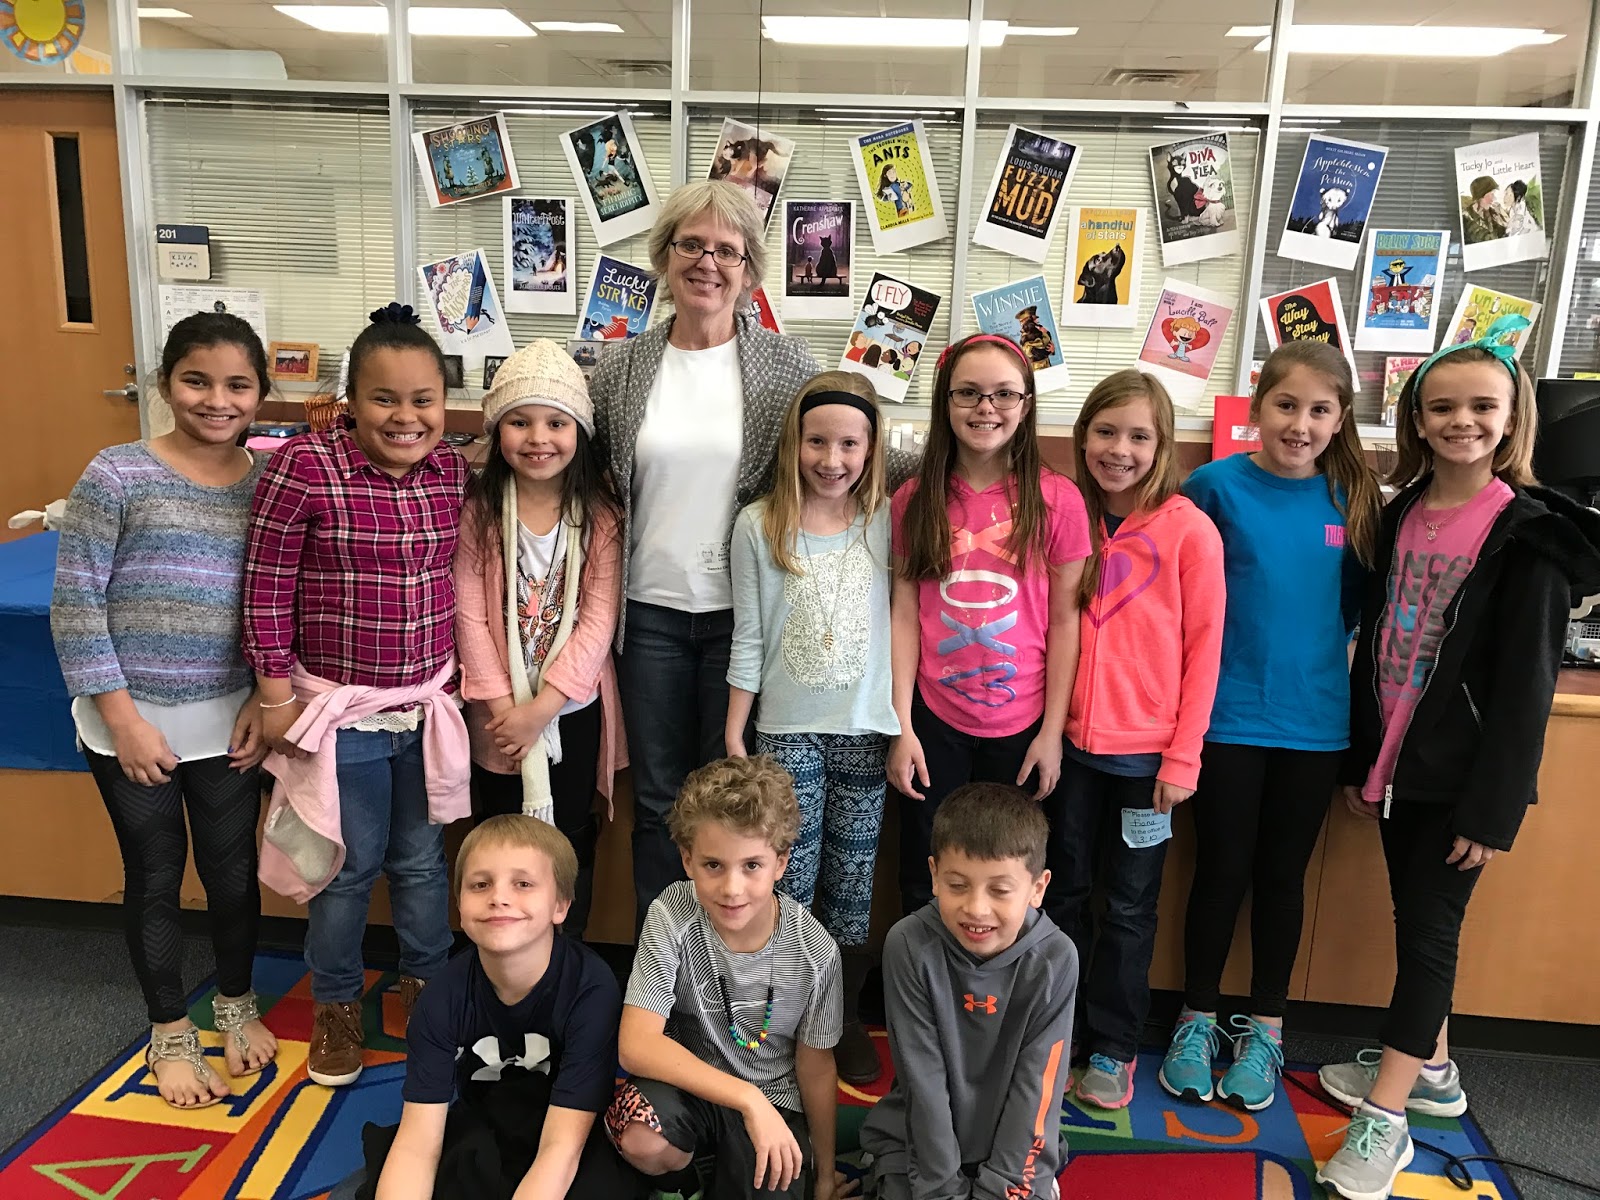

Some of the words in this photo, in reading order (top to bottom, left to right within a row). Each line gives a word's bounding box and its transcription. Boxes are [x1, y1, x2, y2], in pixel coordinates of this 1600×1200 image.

[873, 145, 910, 167] ANTS
[1461, 160, 1483, 172] Tucky
[1485, 158, 1493, 170] Jo
[1010, 156, 1032, 170] LOUIS
[1034, 163, 1063, 179] SACHAR
[1192, 165, 1217, 179] FLEA
[1493, 164, 1512, 175] Little
[1514, 162, 1535, 171] Heart
[1005, 165, 1059, 192] FUZZY
[993, 179, 1054, 225] MUD
[159, 229, 177, 239] 201
[793, 215, 843, 245] Crenshaw
[1081, 221, 1087, 229] a
[1088, 219, 1133, 231] handful
[1086, 230, 1096, 240] of
[1098, 230, 1126, 240] stars
[1377, 233, 1410, 249] BILLY
[1411, 234, 1440, 250] SURE
[450, 275, 461, 289] THE
[603, 266, 650, 294] Lucky
[443, 273, 472, 320] ANSWERS
[875, 284, 883, 300] I
[885, 286, 909, 305] FLY
[978, 286, 1043, 317] WINNIE
[1284, 302, 1298, 311] The
[1168, 306, 1197, 317] Lucille
[1197, 311, 1218, 327] Ball
[1280, 307, 1310, 325] Way
[1292, 320, 1319, 338] Stay
[1400, 357, 1419, 366] REX
